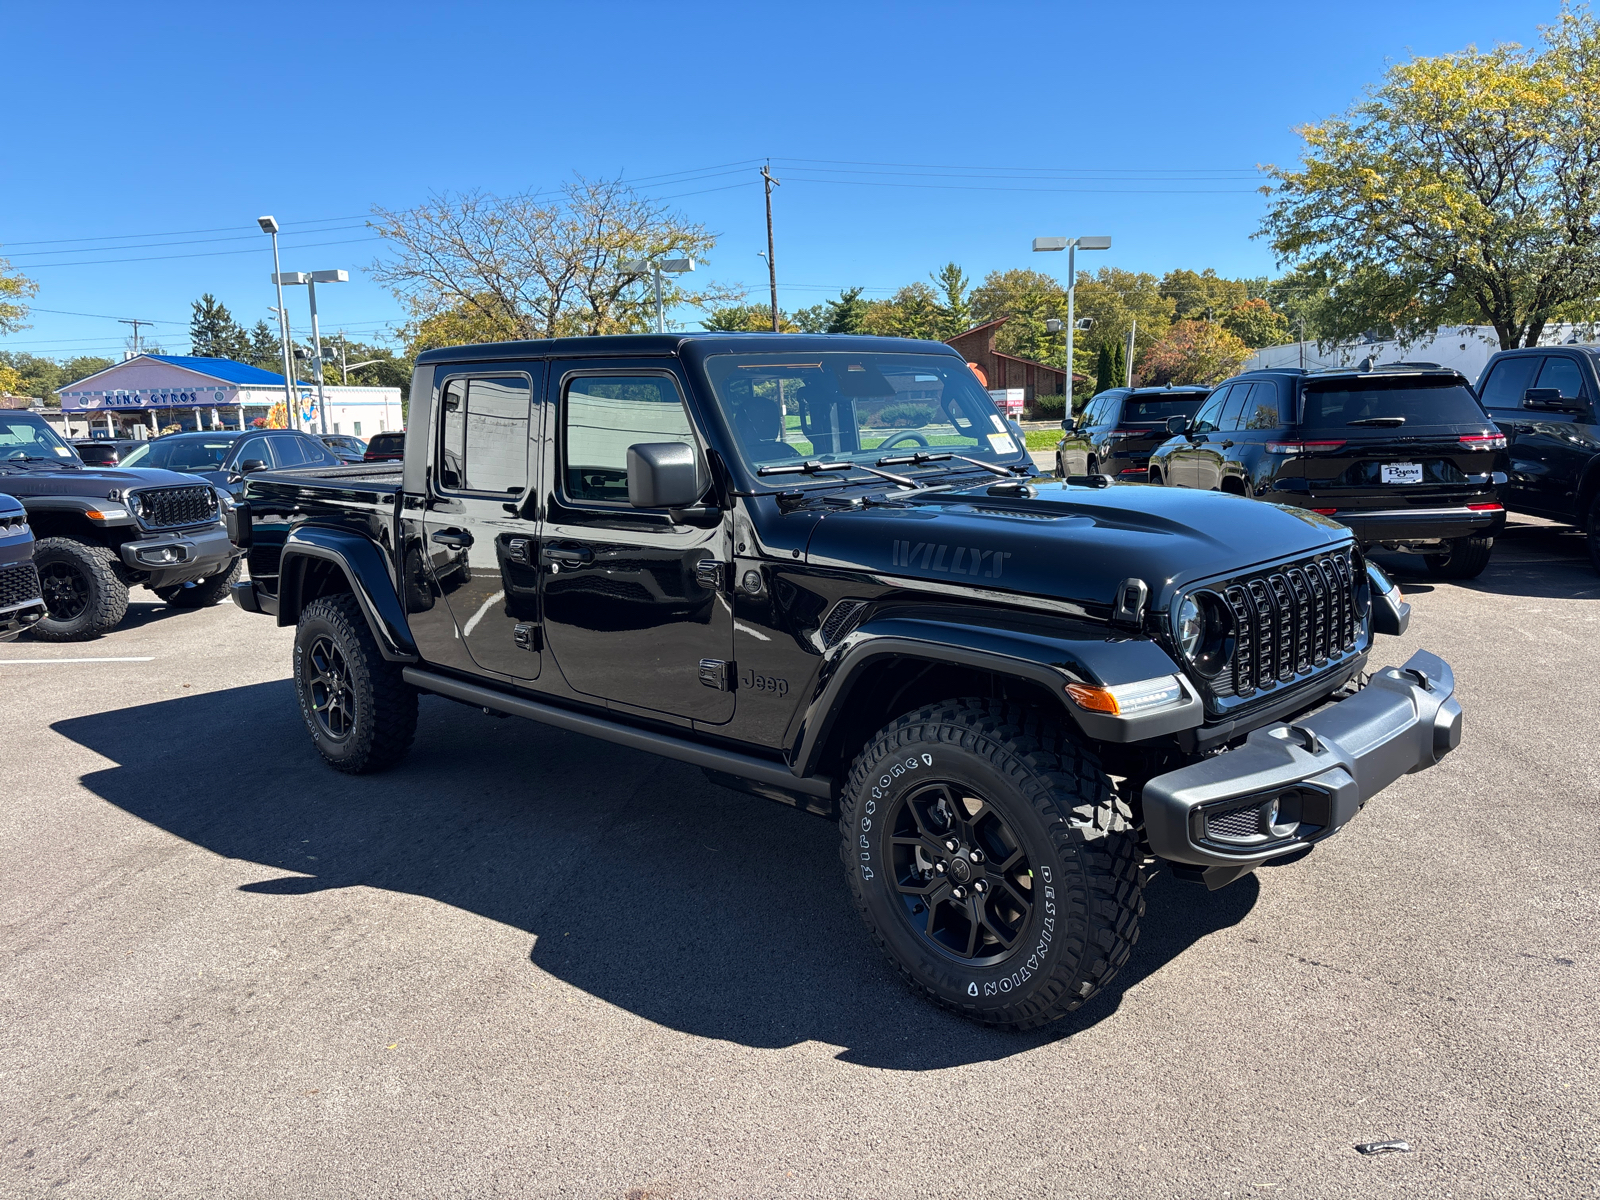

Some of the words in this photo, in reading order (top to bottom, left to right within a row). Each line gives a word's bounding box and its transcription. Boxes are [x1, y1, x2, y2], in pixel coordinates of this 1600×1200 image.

[104, 394, 143, 406] KING
[150, 391, 197, 404] GYROS
[1385, 467, 1419, 478] Byers
[892, 539, 1012, 579] WILLYS
[742, 668, 789, 698] Jeep
[860, 757, 919, 881] Firestone
[983, 865, 1056, 996] DESTINATION
